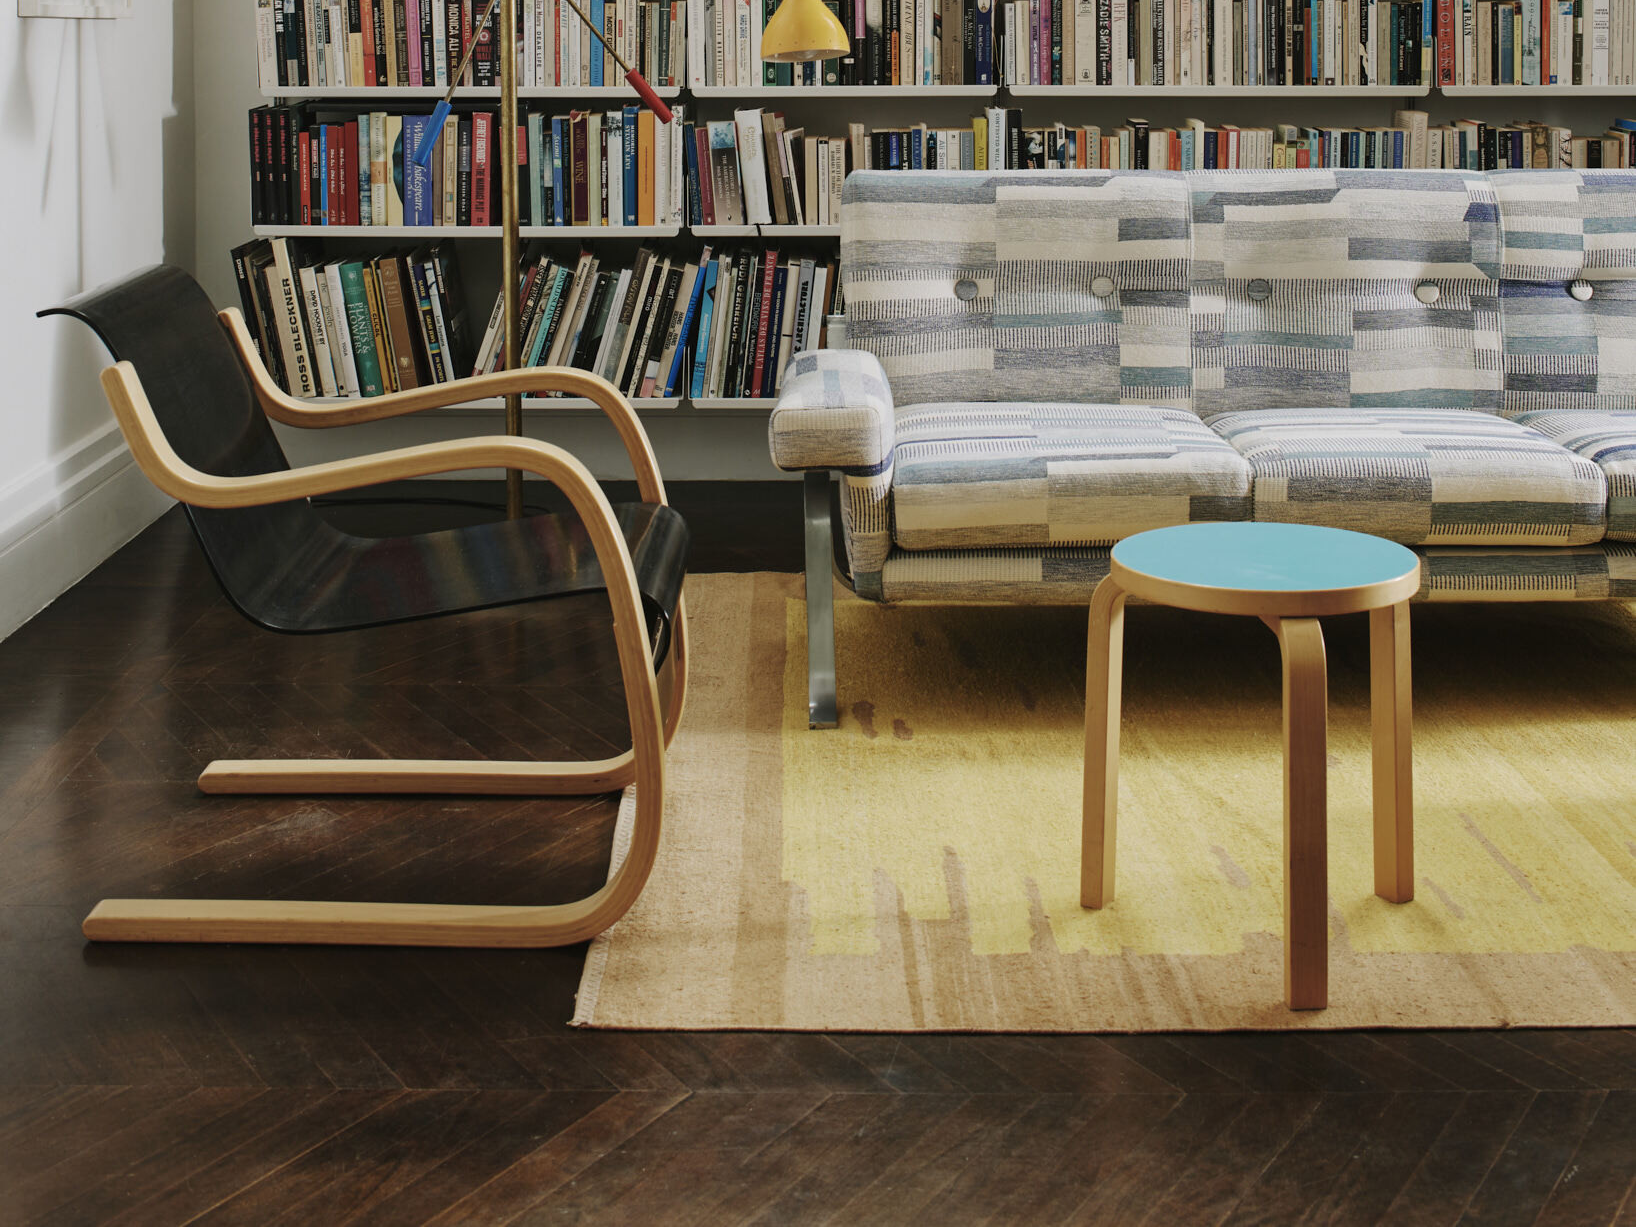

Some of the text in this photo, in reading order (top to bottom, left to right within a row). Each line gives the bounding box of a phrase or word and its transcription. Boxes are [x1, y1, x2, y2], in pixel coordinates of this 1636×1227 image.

[275, 10, 284, 23] LIKE
[276, 23, 284, 33] ME
[448, 3, 459, 36] MONICA
[1099, 0, 1110, 61] ZADIE SMITH
[1464, 15, 1472, 37] RAIN
[449, 37, 460, 51] ALI
[411, 165, 427, 211] hakespeare
[738, 258, 749, 281] RUDI
[310, 289, 318, 308] DAVID
[667, 288, 677, 300] art
[312, 308, 324, 337] HOCKNEY
[354, 301, 368, 343] PLANTS
[758, 321, 767, 336] DES
[763, 288, 771, 298] DE
[796, 280, 809, 344] ARCHITECTURE
[282, 277, 312, 394] ROSS BLECKNER
[347, 302, 362, 355] FLOWERS
